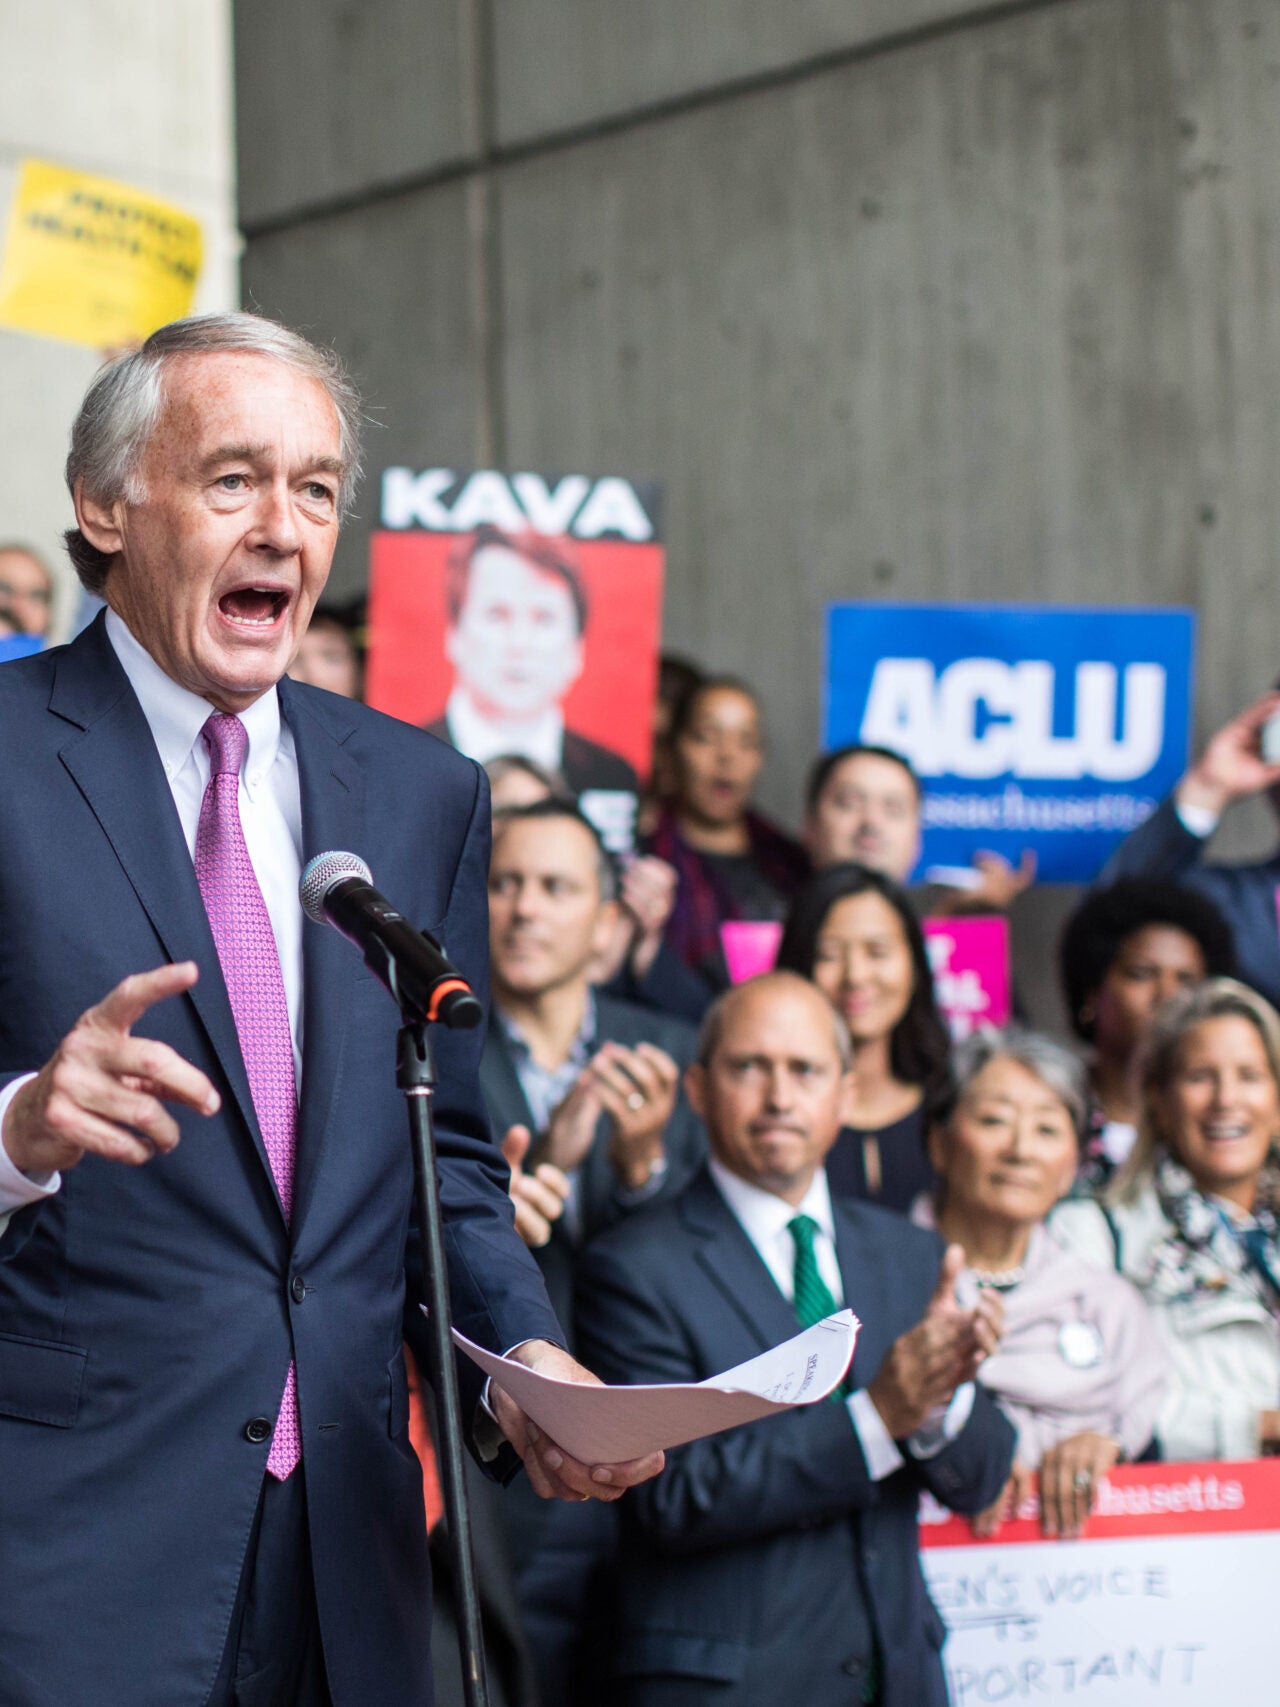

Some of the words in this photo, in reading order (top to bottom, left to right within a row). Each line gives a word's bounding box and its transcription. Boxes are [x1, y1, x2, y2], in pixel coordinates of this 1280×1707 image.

[381, 466, 653, 541] KAVA
[859, 656, 1168, 782] ACLU
[1035, 1566, 1170, 1605] VOICE
